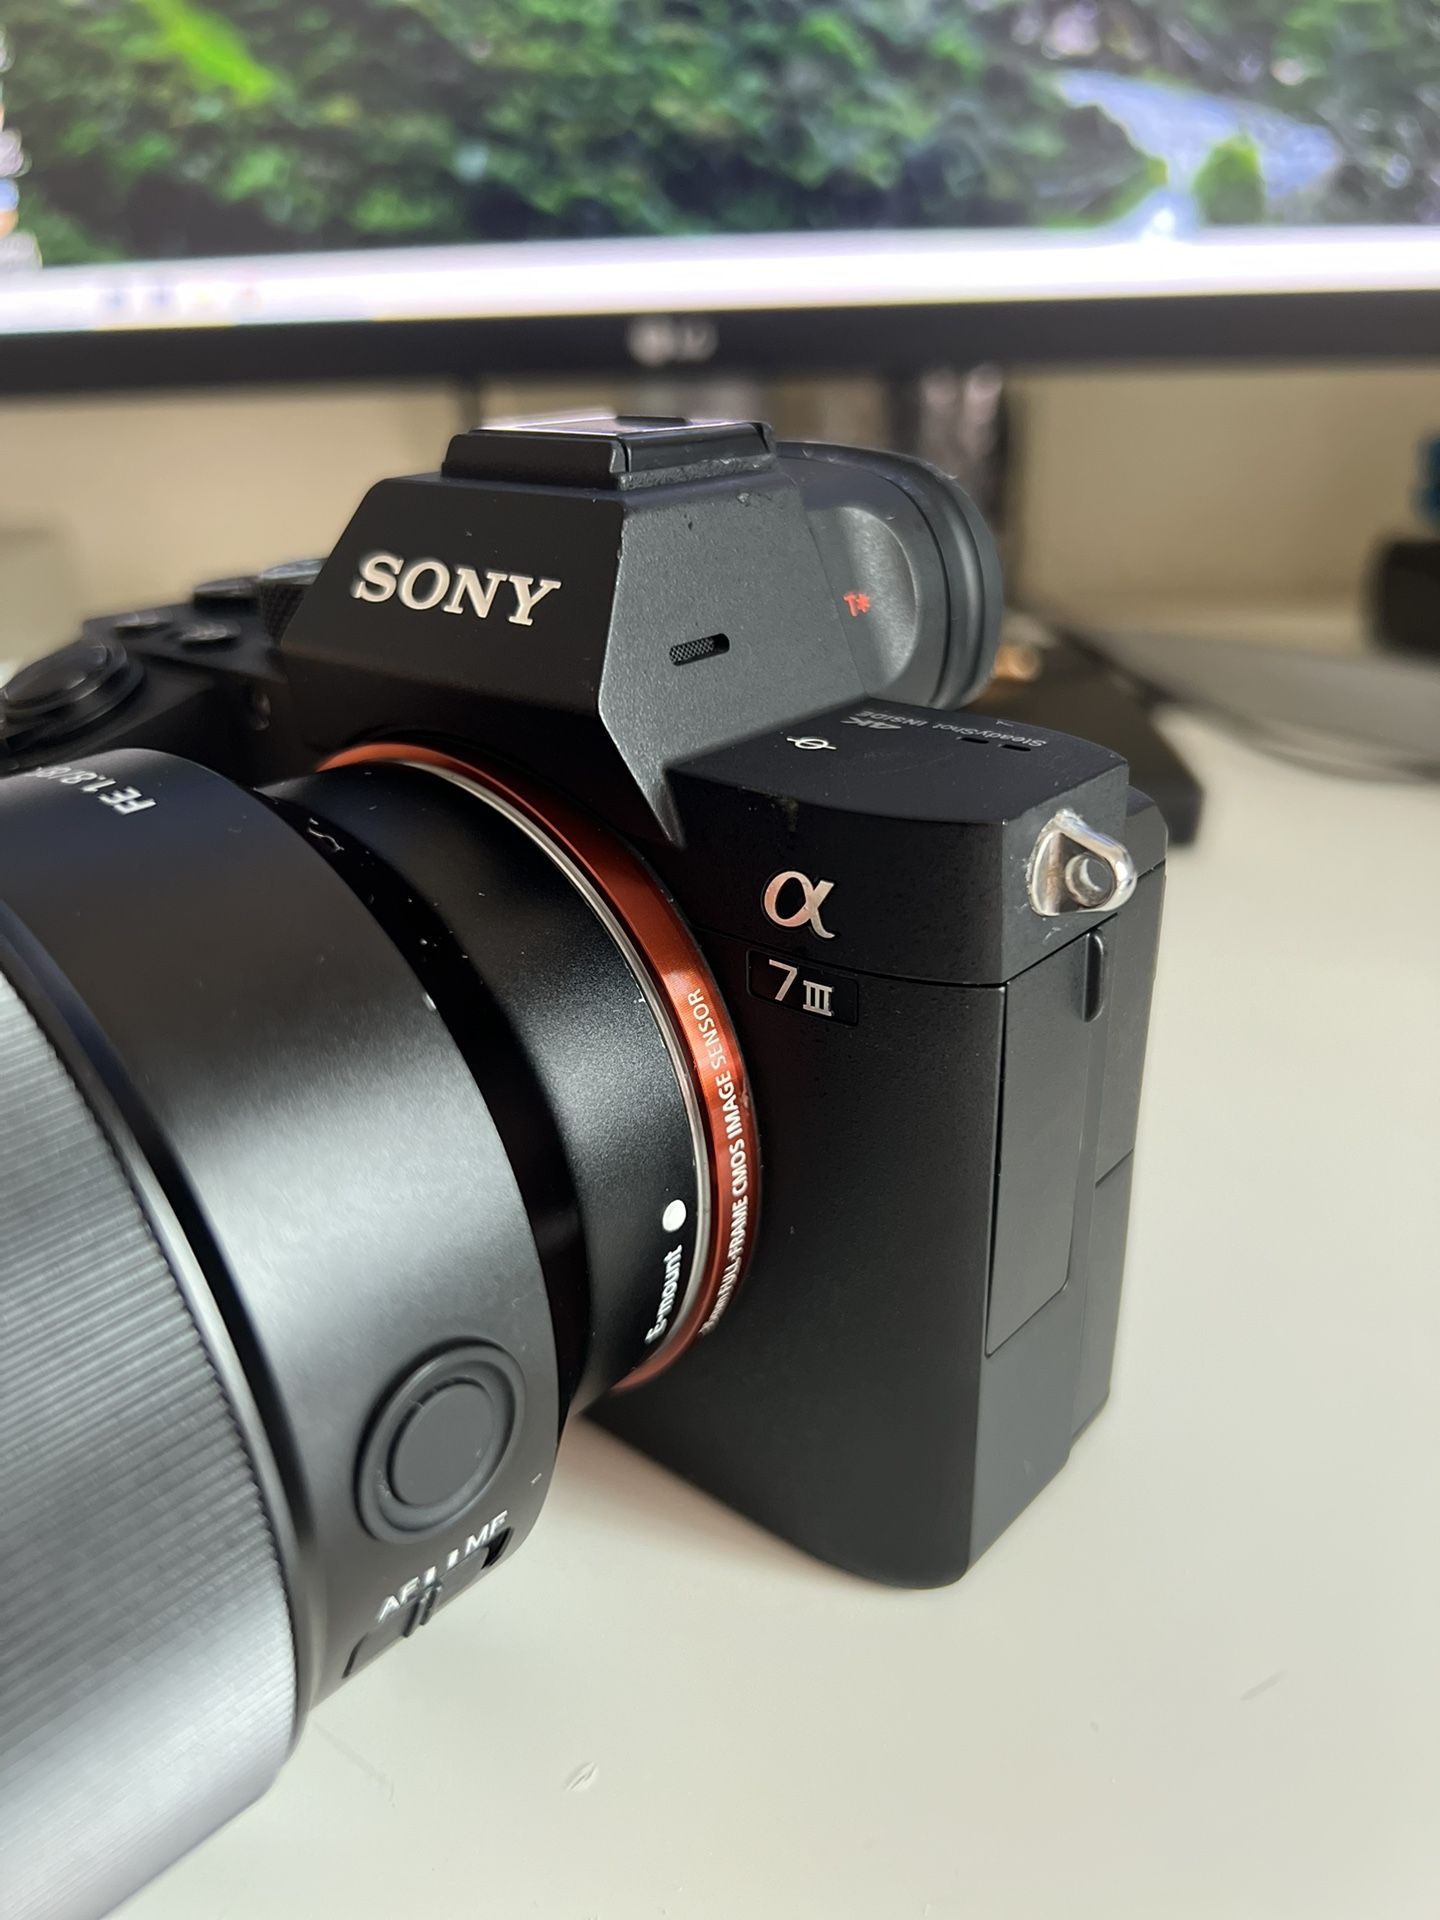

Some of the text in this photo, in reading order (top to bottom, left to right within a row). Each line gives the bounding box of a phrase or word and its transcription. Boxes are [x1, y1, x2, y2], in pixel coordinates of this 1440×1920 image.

[352, 554, 562, 626] SONY
[840, 716, 902, 730] 4K
[855, 710, 1048, 748] SteadyShot INSIDE
[98, 786, 157, 815] FE
[687, 988, 728, 1070] SENSOR
[715, 1069, 744, 1140] IMAGE
[728, 1137, 749, 1198] CMOS
[644, 1243, 683, 1344] E-mount
[376, 1509, 509, 1623] AF MF
